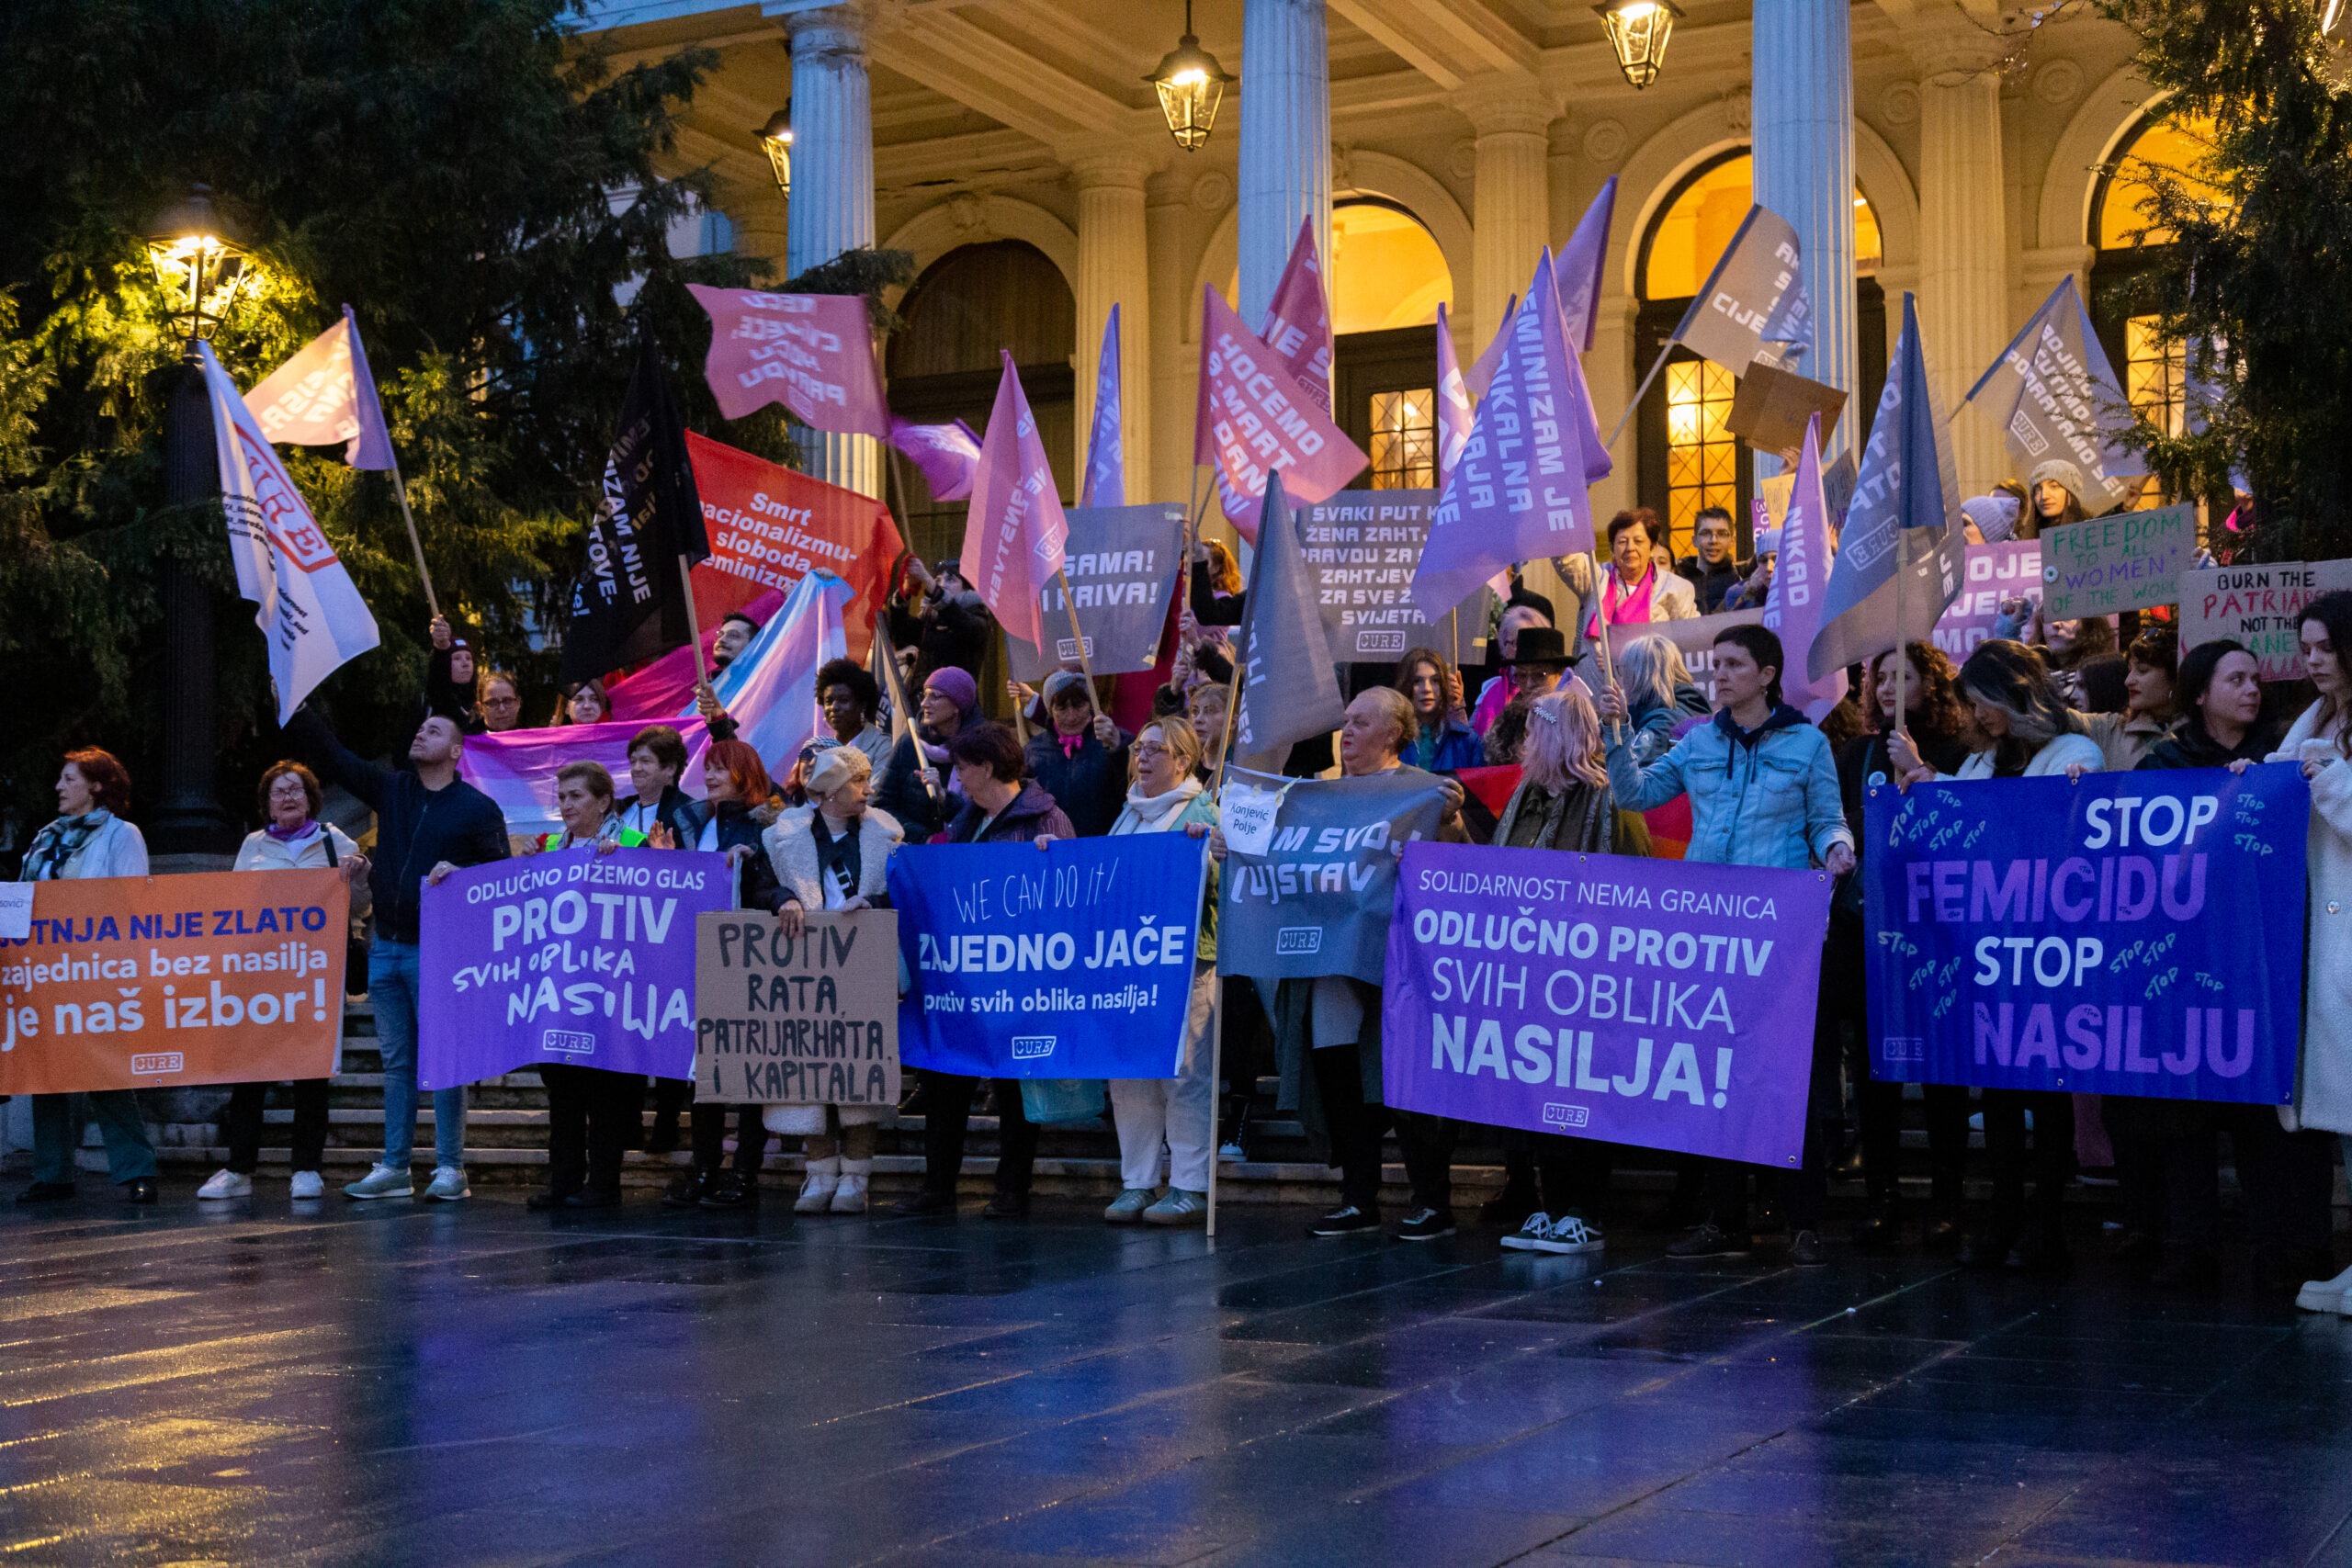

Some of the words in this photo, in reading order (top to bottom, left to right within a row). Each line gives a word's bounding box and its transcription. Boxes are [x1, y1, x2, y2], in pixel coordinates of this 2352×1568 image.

[1218, 333, 1325, 456] HOĆEMO
[1516, 282, 1565, 476] EMINIZAM
[1544, 487, 1575, 531] JE
[1223, 385, 1296, 470] MART
[750, 492, 812, 525] Smrt
[1312, 506, 1374, 522] SVAKI
[1380, 505, 1420, 521] PUT
[716, 531, 811, 574] sloboda
[1306, 525, 1359, 542] ŽENA
[1365, 527, 1428, 542] ZAHT
[2053, 513, 2181, 555] FREEDOM
[621, 544, 651, 604] NIJE
[1385, 548, 1411, 563] ZA
[1784, 506, 1810, 606] NIKAD
[1969, 551, 2041, 581] OJE
[2065, 555, 2165, 590] WOMEN
[2075, 552, 2098, 568] TO
[2122, 544, 2151, 558] ALL
[1320, 569, 1417, 584] ZAHTJEV
[2218, 572, 2269, 590] BURN
[2278, 571, 2315, 587] THE
[1057, 582, 1158, 611] KRIVA!
[1320, 590, 1347, 604] ZA
[1352, 590, 1395, 604] SVE
[2089, 589, 2119, 606] THE
[1341, 609, 1425, 625] SVIJETA
[2241, 617, 2268, 632] NOT
[1059, 641, 1091, 656] CUE
[1361, 635, 1401, 648] CURE
[1233, 818, 1257, 835] Polje
[2084, 795, 2219, 849] STOP
[467, 869, 562, 904] ODLUČNO
[567, 860, 650, 886] DIŽEMO
[656, 868, 706, 891] GLAS
[953, 879, 991, 923] WE
[1003, 869, 1046, 917] CAN
[1055, 865, 1078, 908] DO
[1419, 869, 1571, 902] SOLIDARNOST
[1577, 883, 1652, 909] NEMA
[1660, 888, 1777, 920] GRANICA
[1905, 852, 2205, 922] FEMICIDU
[0, 916, 120, 947] TNJA
[130, 911, 203, 940] NIJE
[213, 907, 327, 936] ZLATO
[493, 890, 677, 952] PROTIV
[1281, 932, 1318, 948] CURE
[529, 940, 635, 978] OBLIKA
[718, 923, 857, 969] PROTIV
[919, 932, 1075, 973] ZAJEDNO
[1084, 915, 1186, 969] JAČE
[1413, 906, 1598, 959] ODLUČNO
[1608, 926, 1774, 976] PROTIV
[2, 953, 138, 992] zajednica
[151, 949, 210, 976] bez
[222, 942, 328, 978] nasilja
[452, 956, 520, 992] SVIH
[1974, 936, 2103, 987] STOP
[749, 975, 846, 1017] RATA,
[924, 990, 965, 1015] protiv
[970, 989, 1013, 1012] svih
[1021, 987, 1086, 1011] oblika
[1091, 984, 1158, 1014] nasilja!
[1431, 957, 1528, 1010] SVIH
[1544, 969, 1735, 1033] OBLIKA
[1, 995, 39, 1052] je
[55, 987, 144, 1034] naš
[164, 978, 326, 1029] izbor!
[547, 1033, 591, 1050] CURE
[1016, 1041, 1053, 1055] CURE
[1887, 1043, 1923, 1056] CUE
[1973, 1002, 2256, 1077] NASILJU
[135, 1055, 179, 1072] CURE
[1431, 1013, 1734, 1110] NASILJA!
[746, 1060, 885, 1102] KAPITALA
[1547, 1108, 1585, 1122] CURE
